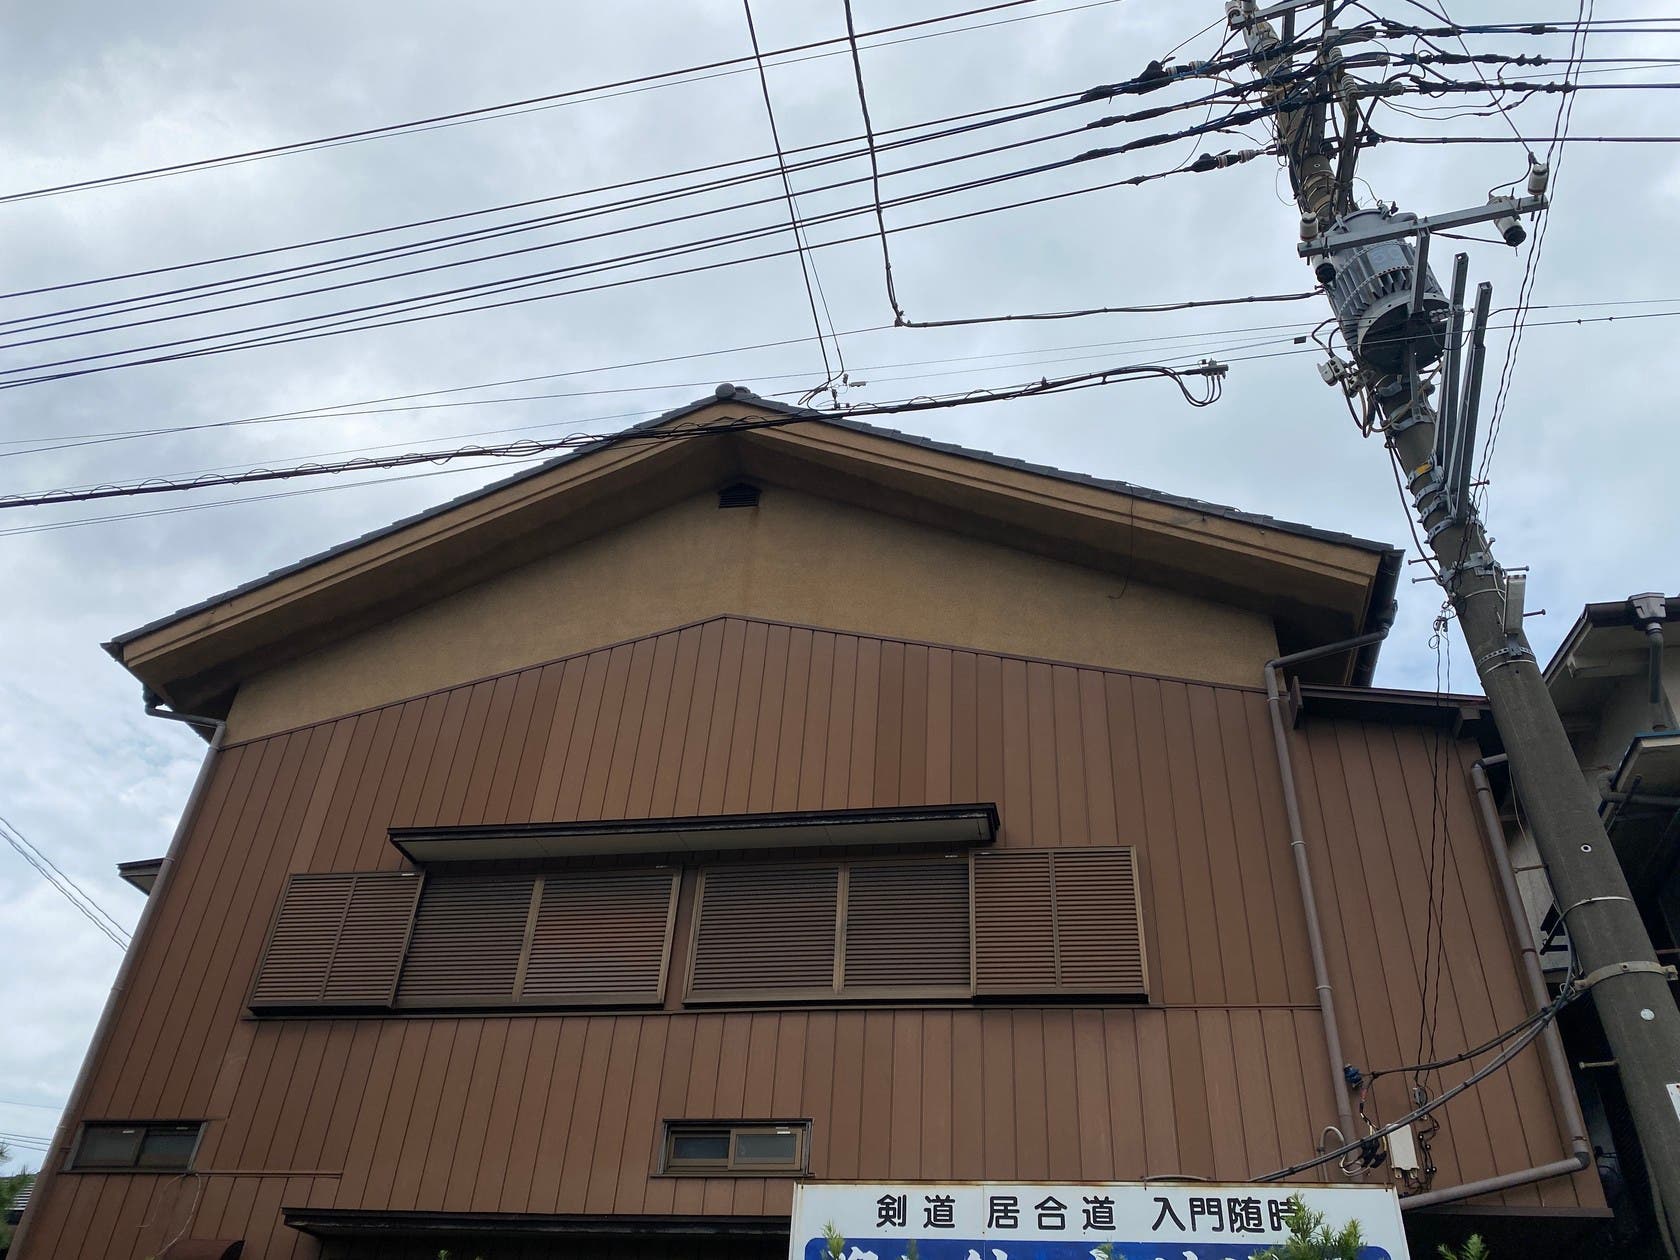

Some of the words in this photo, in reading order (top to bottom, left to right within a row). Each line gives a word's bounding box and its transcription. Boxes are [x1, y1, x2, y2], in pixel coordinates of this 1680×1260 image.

[876, 1194, 955, 1228] 剣道
[987, 1195, 1116, 1231] 居合道
